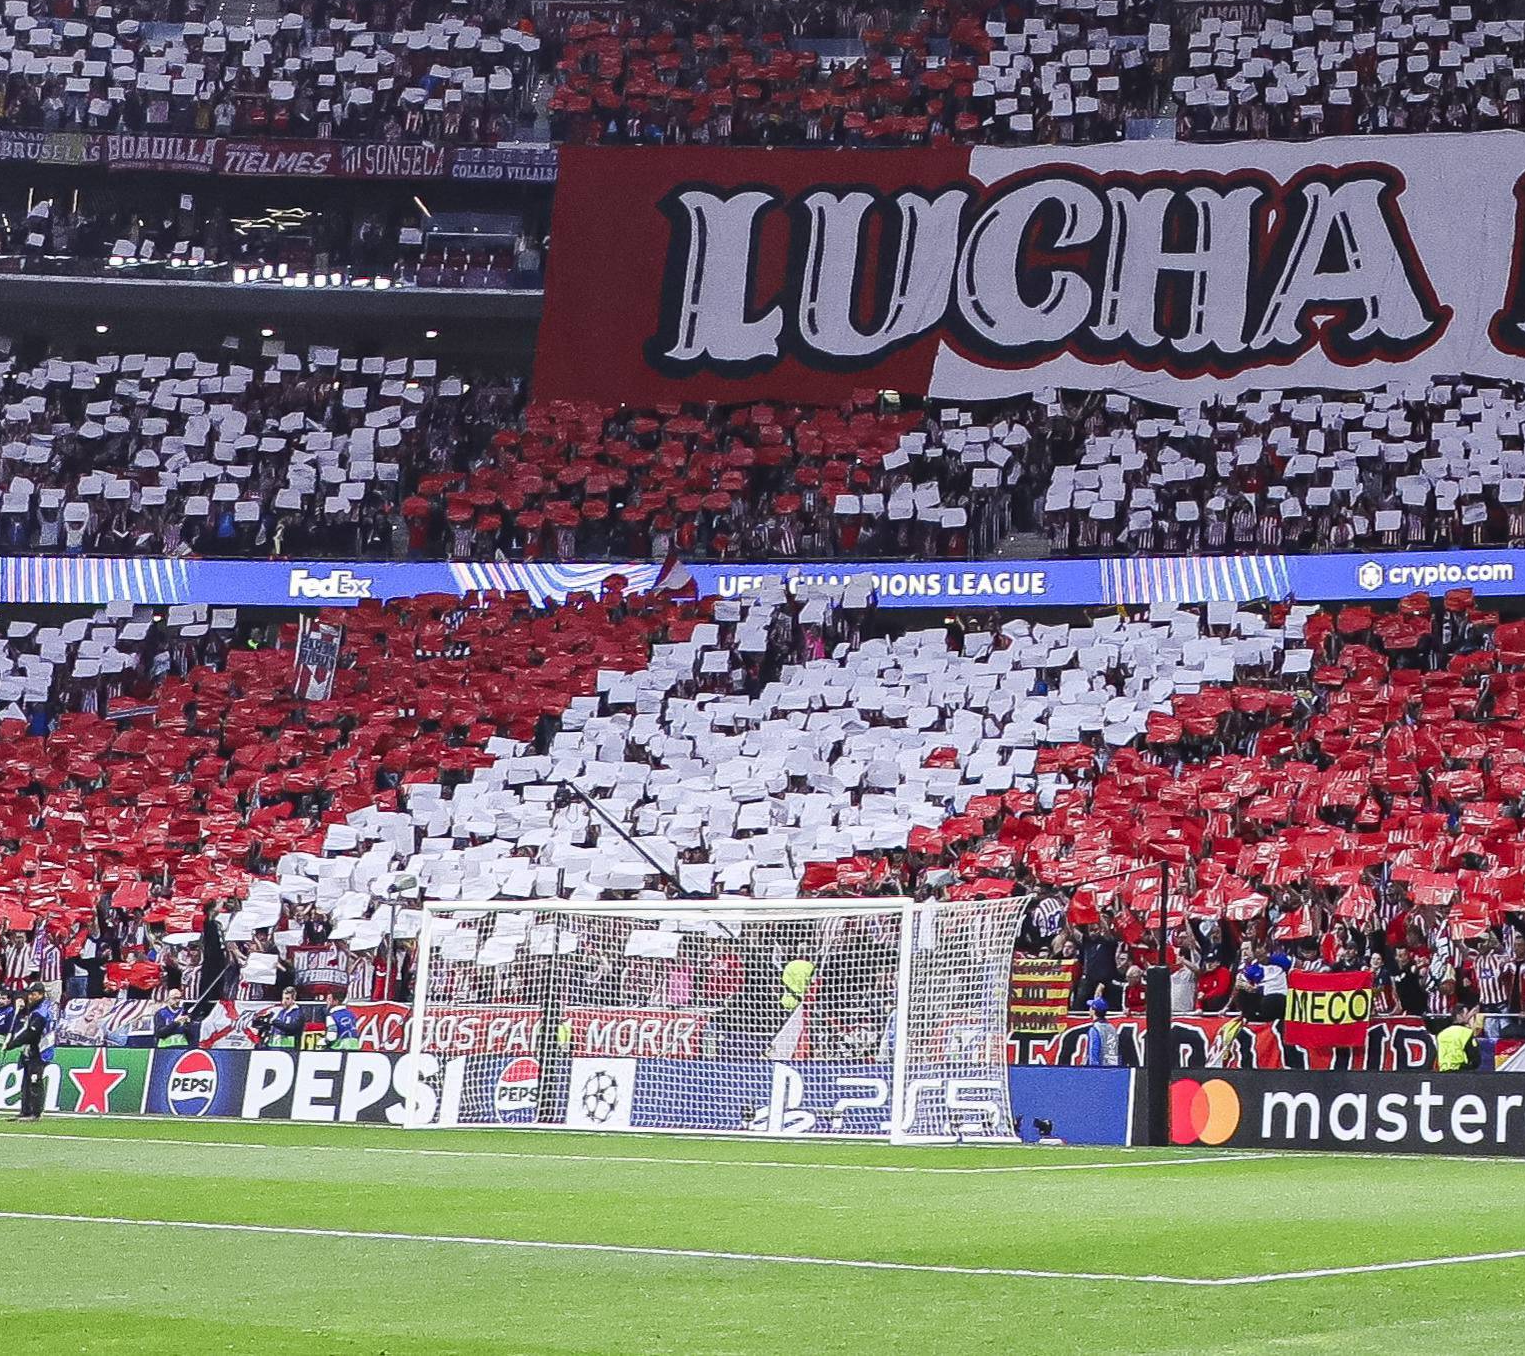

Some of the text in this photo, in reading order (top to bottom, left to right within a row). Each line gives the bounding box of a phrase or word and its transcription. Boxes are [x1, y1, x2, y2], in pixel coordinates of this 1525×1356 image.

[107, 135, 217, 165] BOADILLA
[223, 150, 332, 175] TIELMES
[364, 144, 445, 176] SONSECA
[451, 164, 504, 180] COLLADO
[663, 175, 1437, 363] LUCHA
[288, 568, 373, 599] FedEx
[718, 570, 1047, 598] UEF CIONS LEAGUE
[1386, 560, 1514, 587] crypto.com
[1291, 989, 1371, 1025] MECO
[586, 1017, 698, 1055] MORIR
[171, 1077, 213, 1093] PEPSI
[240, 1051, 465, 1125] PEPSI
[498, 1087, 539, 1103] PEPS
[834, 1077, 1003, 1139] PS5
